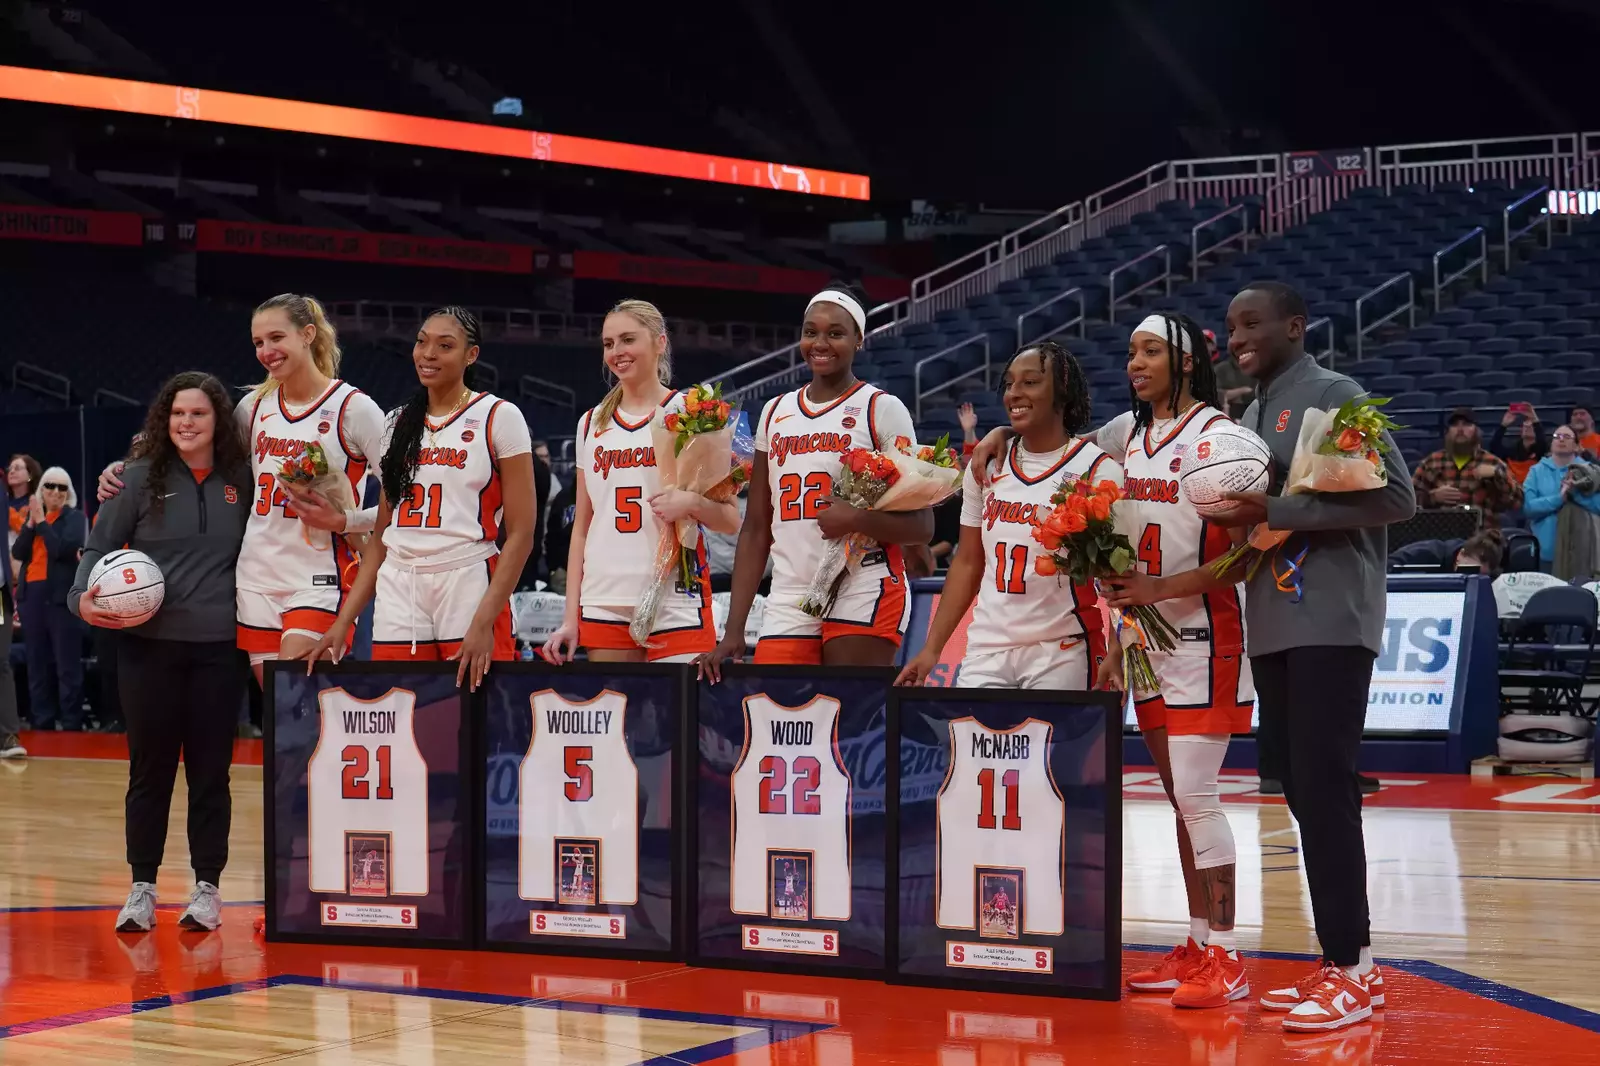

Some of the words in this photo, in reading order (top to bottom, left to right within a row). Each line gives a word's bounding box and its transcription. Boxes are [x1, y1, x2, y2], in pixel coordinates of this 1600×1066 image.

[1292, 158, 1313, 173] 121
[1336, 155, 1361, 170] 122
[1275, 409, 1291, 433] S
[255, 430, 307, 464] Syracu
[415, 446, 468, 470] acuse
[769, 432, 852, 467] Syracuse
[593, 445, 657, 480] Syracu
[224, 485, 238, 504] S
[397, 483, 442, 528] 21
[779, 471, 833, 521] 22
[615, 486, 642, 533] 5
[1134, 522, 1162, 577] 4
[122, 568, 137, 585] S
[995, 541, 1028, 594] 11
[1375, 617, 1453, 673] NS
[343, 710, 395, 734] WILSON
[546, 710, 612, 734] WOOLLEY
[771, 720, 813, 746] WOOD
[972, 733, 1030, 760] McNABB
[341, 745, 393, 800] 21
[563, 745, 593, 802] 5
[758, 755, 821, 815] 22
[977, 768, 1022, 831] 11
[327, 906, 337, 920] S
[401, 909, 411, 924] S
[536, 914, 546, 930] S
[609, 919, 620, 934] S
[749, 929, 759, 945] S
[823, 935, 834, 951] S
[953, 945, 965, 963] S
[1035, 951, 1047, 968] S
